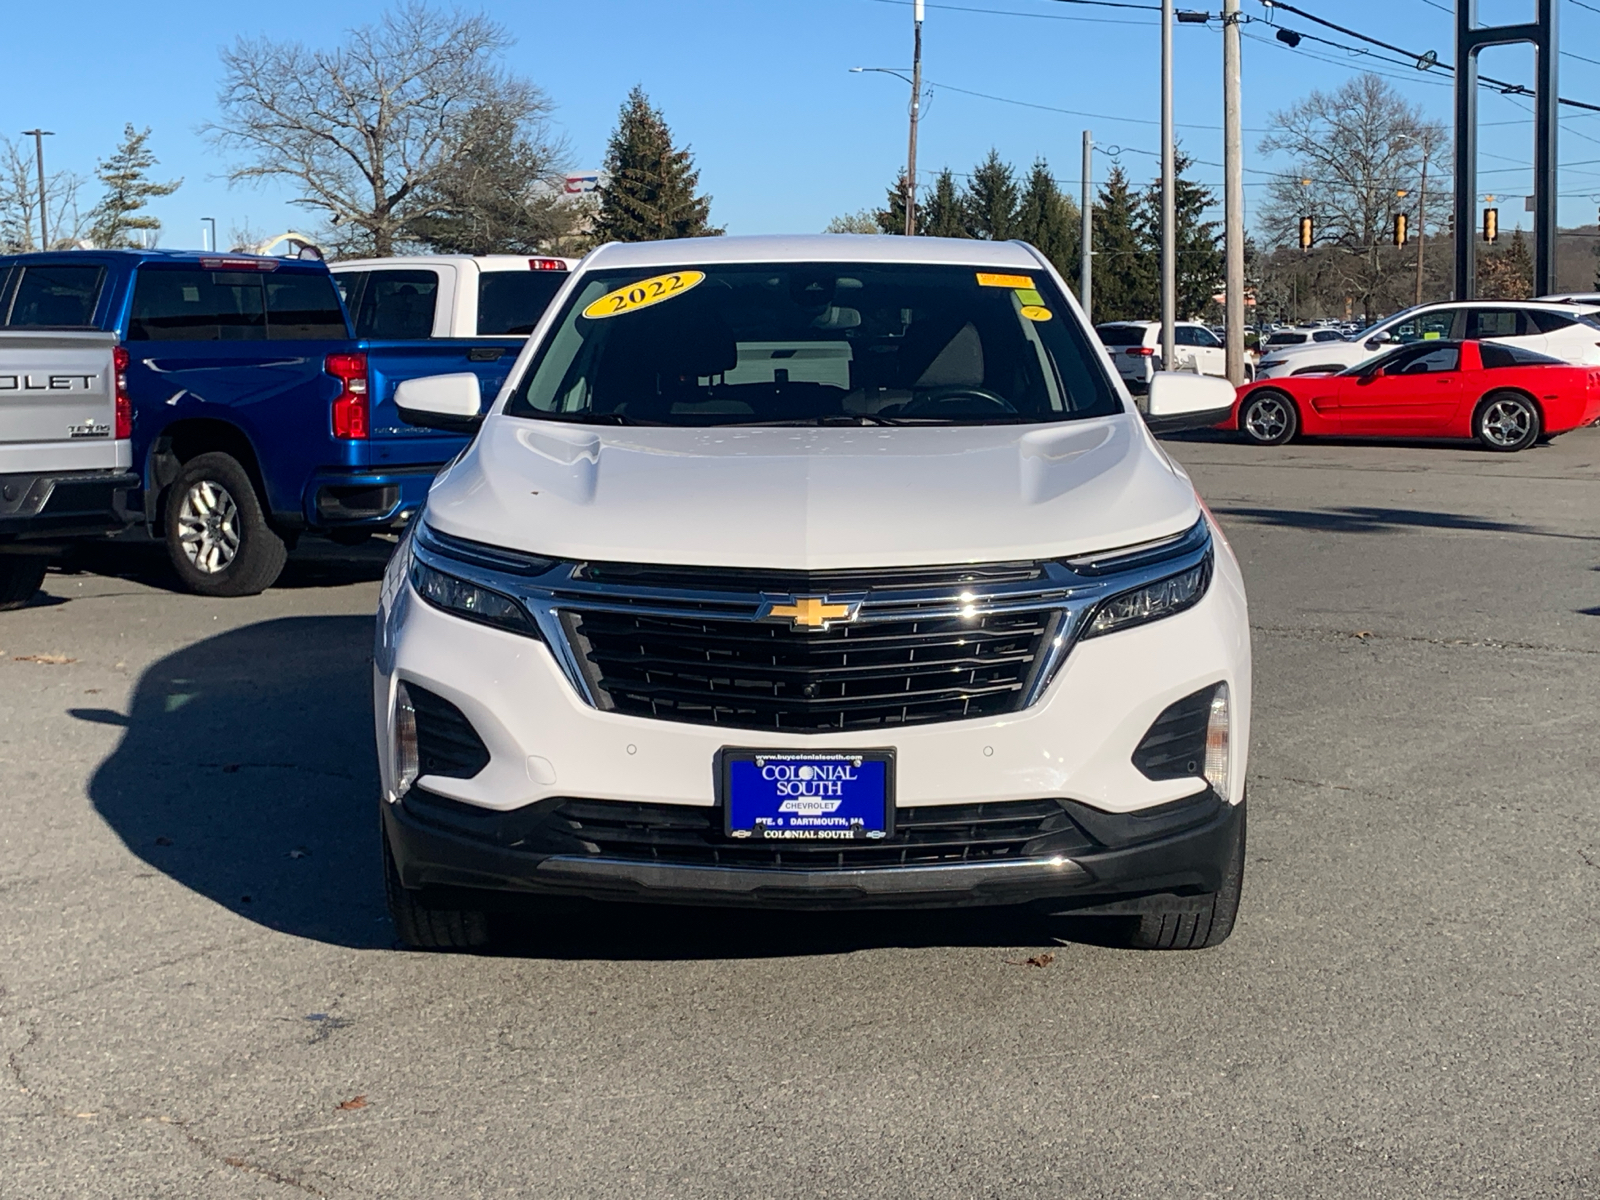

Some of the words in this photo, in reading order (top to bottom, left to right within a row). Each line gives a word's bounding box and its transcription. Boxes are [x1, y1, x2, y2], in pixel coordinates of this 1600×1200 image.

[609, 275, 685, 313] 2022
[755, 753, 863, 761] www.buycolonialsouth.com
[761, 765, 858, 780] COLONIAL
[776, 781, 843, 796] SOUTH
[785, 802, 835, 810] CHEVROLET
[777, 817, 784, 826] 6
[790, 817, 849, 826] DARTMOUTH,
[763, 830, 817, 839] COLONIAL
[818, 830, 855, 839] SOUTH
